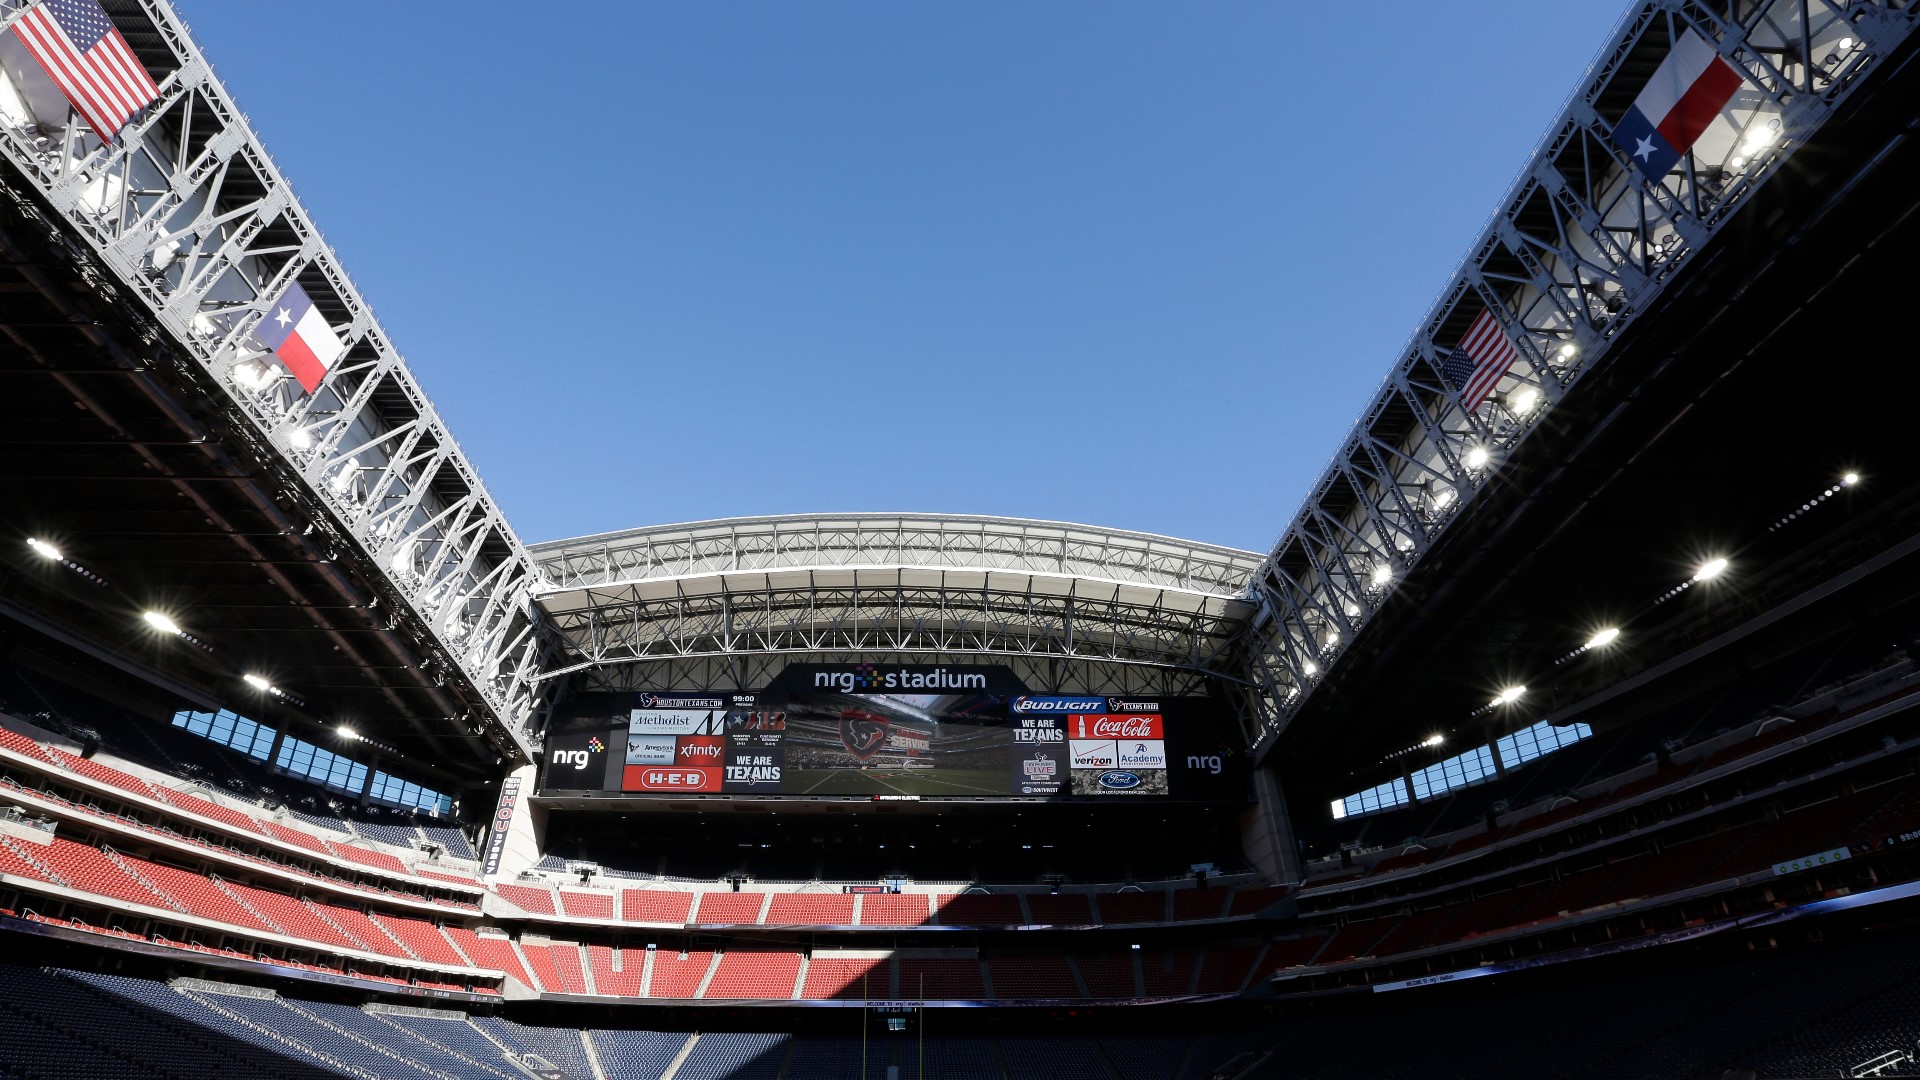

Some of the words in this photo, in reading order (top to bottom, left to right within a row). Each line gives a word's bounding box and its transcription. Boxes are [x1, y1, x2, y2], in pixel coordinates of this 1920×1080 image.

[814, 672, 854, 693] nrg
[884, 668, 986, 688] stadium
[1020, 700, 1054, 710] BUD
[1054, 700, 1101, 710] LIGHT
[635, 715, 690, 726] Methodist
[1021, 719, 1036, 728] WE
[1037, 719, 1055, 728] ARE
[1093, 717, 1154, 737] Coca-Cola
[1013, 728, 1064, 741] TEXANS
[891, 735, 931, 751] SERVICE
[680, 743, 722, 758] xfinity
[552, 750, 589, 770] nrg
[736, 755, 751, 765] WE
[752, 756, 772, 766] ARE
[1074, 756, 1112, 766] verizon
[1120, 755, 1163, 765] Academy
[1187, 755, 1222, 775] nrg
[726, 766, 781, 780] TEXANS
[1026, 766, 1054, 774] LIVE
[649, 773, 700, 785] H-E-B
[1107, 773, 1131, 784] Ford
[496, 796, 516, 832] HOU
